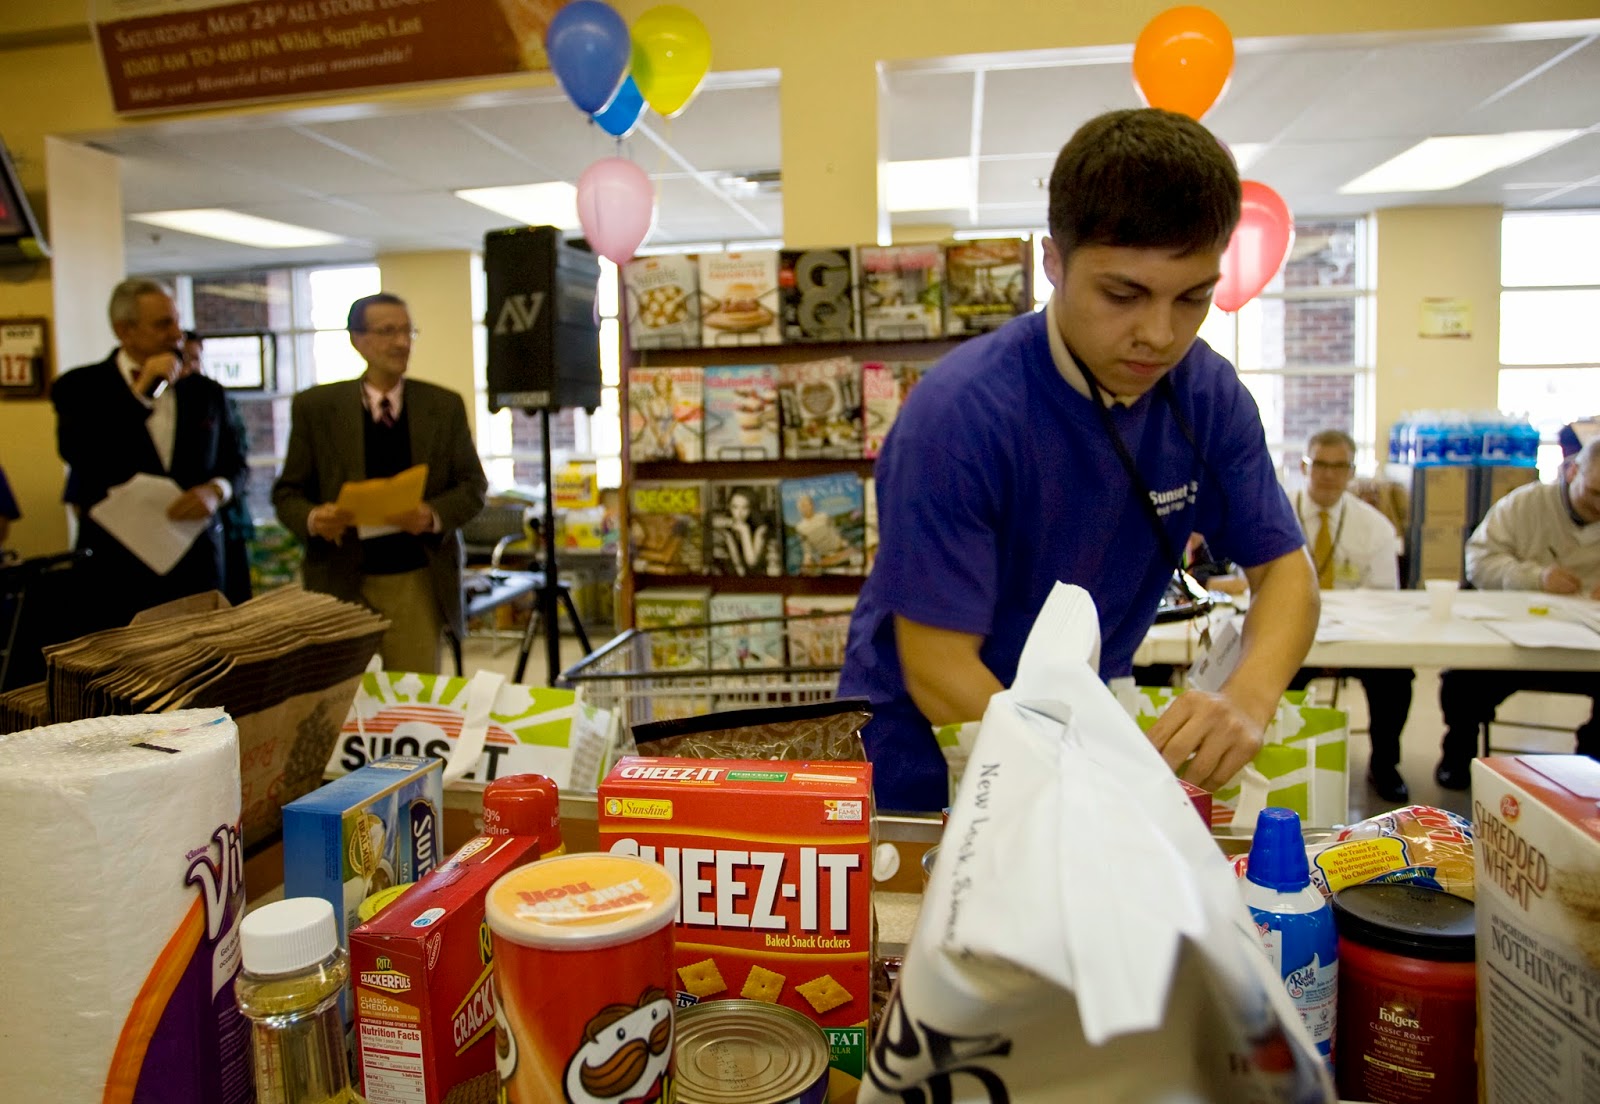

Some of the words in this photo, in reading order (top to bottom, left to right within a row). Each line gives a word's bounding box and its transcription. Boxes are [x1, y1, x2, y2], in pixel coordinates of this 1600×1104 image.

[322, 20, 388, 49] Supplies
[387, 16, 423, 36] Last
[634, 488, 698, 514] DECKS
[341, 735, 510, 781] SUNST
[620, 766, 724, 781] CHEEZ-IT
[975, 763, 1000, 811] New
[624, 801, 669, 816] Sunshine
[1348, 848, 1367, 857] Trans
[1368, 845, 1379, 853] Fat
[1474, 800, 1549, 893] SHREDDED
[1338, 858, 1385, 874] Hydrogenated
[1344, 852, 1377, 864] Saturated
[1480, 841, 1543, 912] WHEAT
[765, 934, 790, 948] Baked
[792, 935, 816, 948] Snack
[817, 935, 850, 949] Crackers
[1491, 925, 1573, 1004] NOTHING
[360, 974, 411, 989] CRACKERFULS
[360, 996, 387, 1004] CLASSIC
[360, 1003, 399, 1013] CHEDDAR
[1378, 1007, 1420, 1029] Folgers
[361, 1025, 396, 1038] Nutrition
[398, 1030, 420, 1041] Facts
[829, 1032, 862, 1045] FAT
[1369, 1022, 1402, 1036] CLASSIC
[1404, 1031, 1431, 1042] ROAST
[831, 1046, 851, 1054] ULAR
